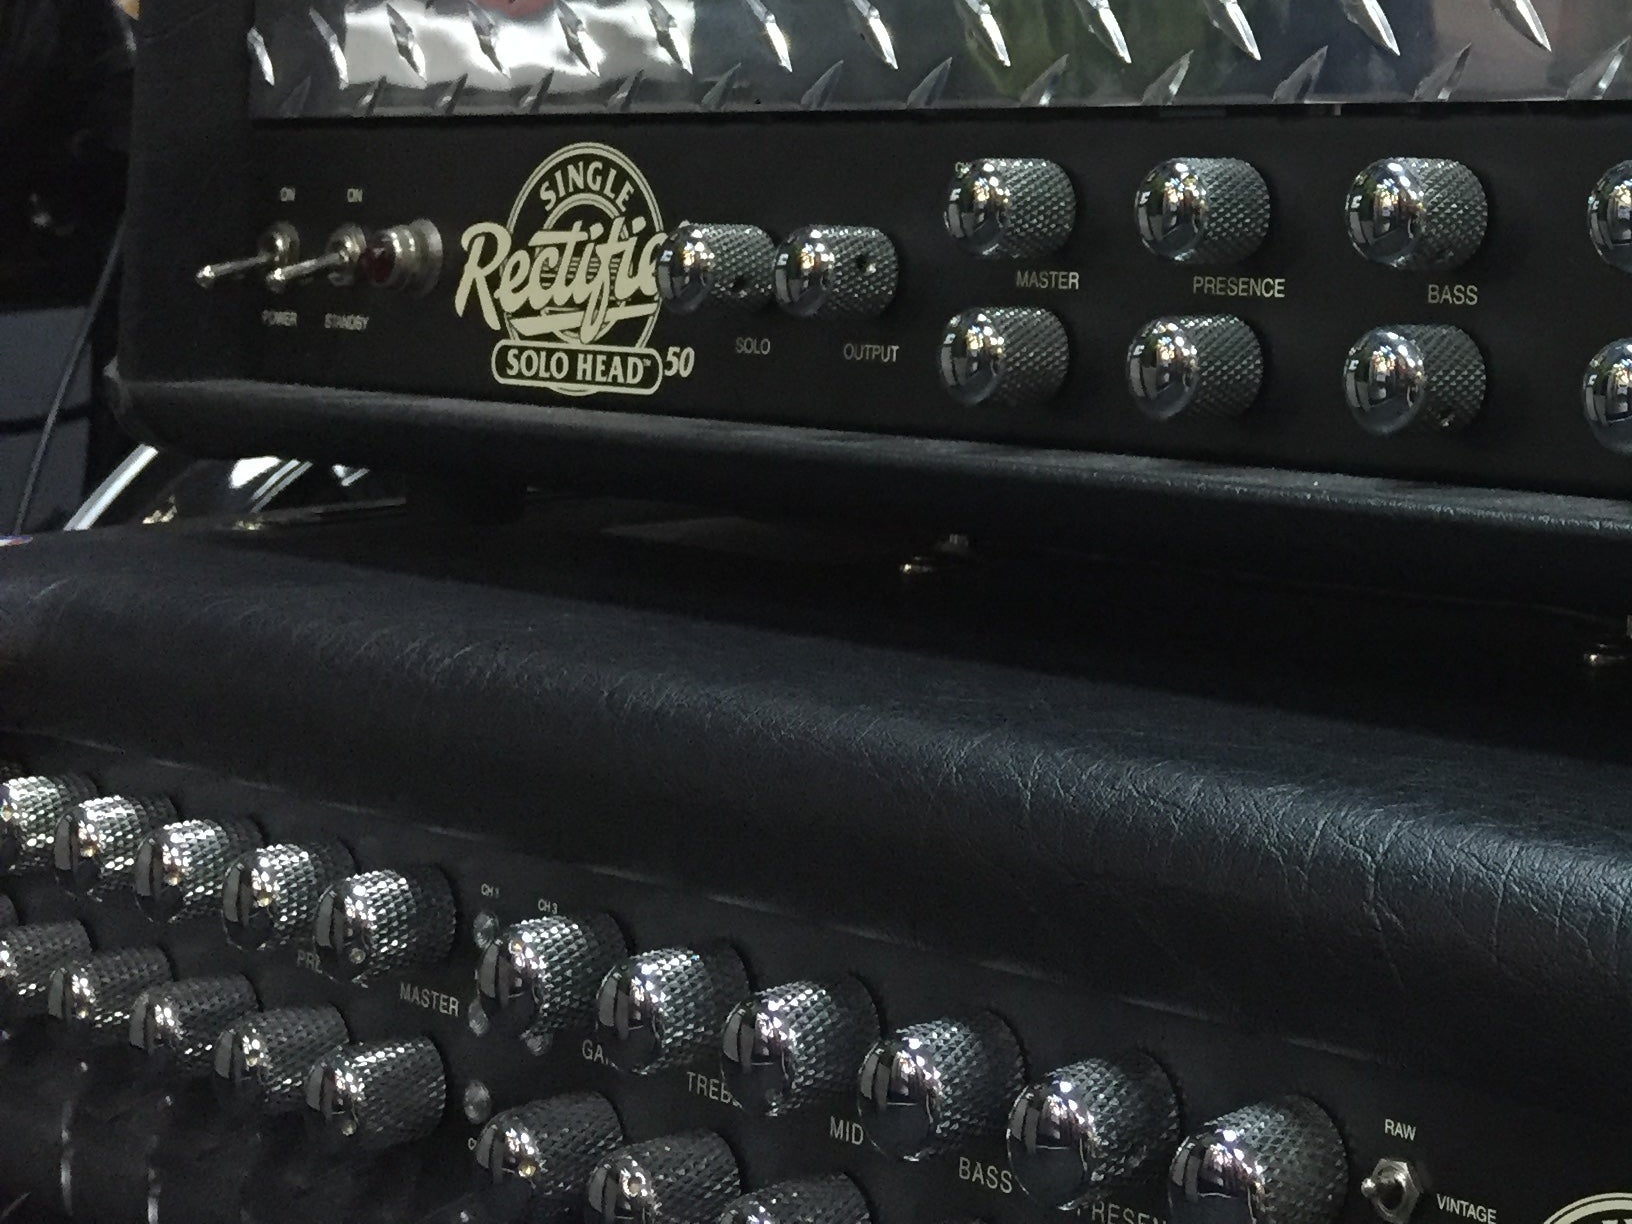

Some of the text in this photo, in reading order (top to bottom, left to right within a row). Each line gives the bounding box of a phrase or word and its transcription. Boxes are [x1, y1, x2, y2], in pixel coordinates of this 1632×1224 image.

[347, 188, 363, 203] ON
[539, 161, 635, 212] SINGLE
[1017, 271, 1079, 290] MASTER
[1193, 277, 1286, 298] PRESENCE
[1428, 285, 1478, 305] BASS
[735, 336, 771, 356] SOLO
[844, 344, 899, 363] OUTPUT
[506, 349, 569, 376] SOLO
[664, 347, 695, 378] 50
[400, 982, 460, 1017] MASTER
[829, 1116, 864, 1145] MID
[1384, 1119, 1417, 1141] RAW
[959, 1156, 1013, 1195] BASS
[1437, 1193, 1497, 1223] VINTAGE
